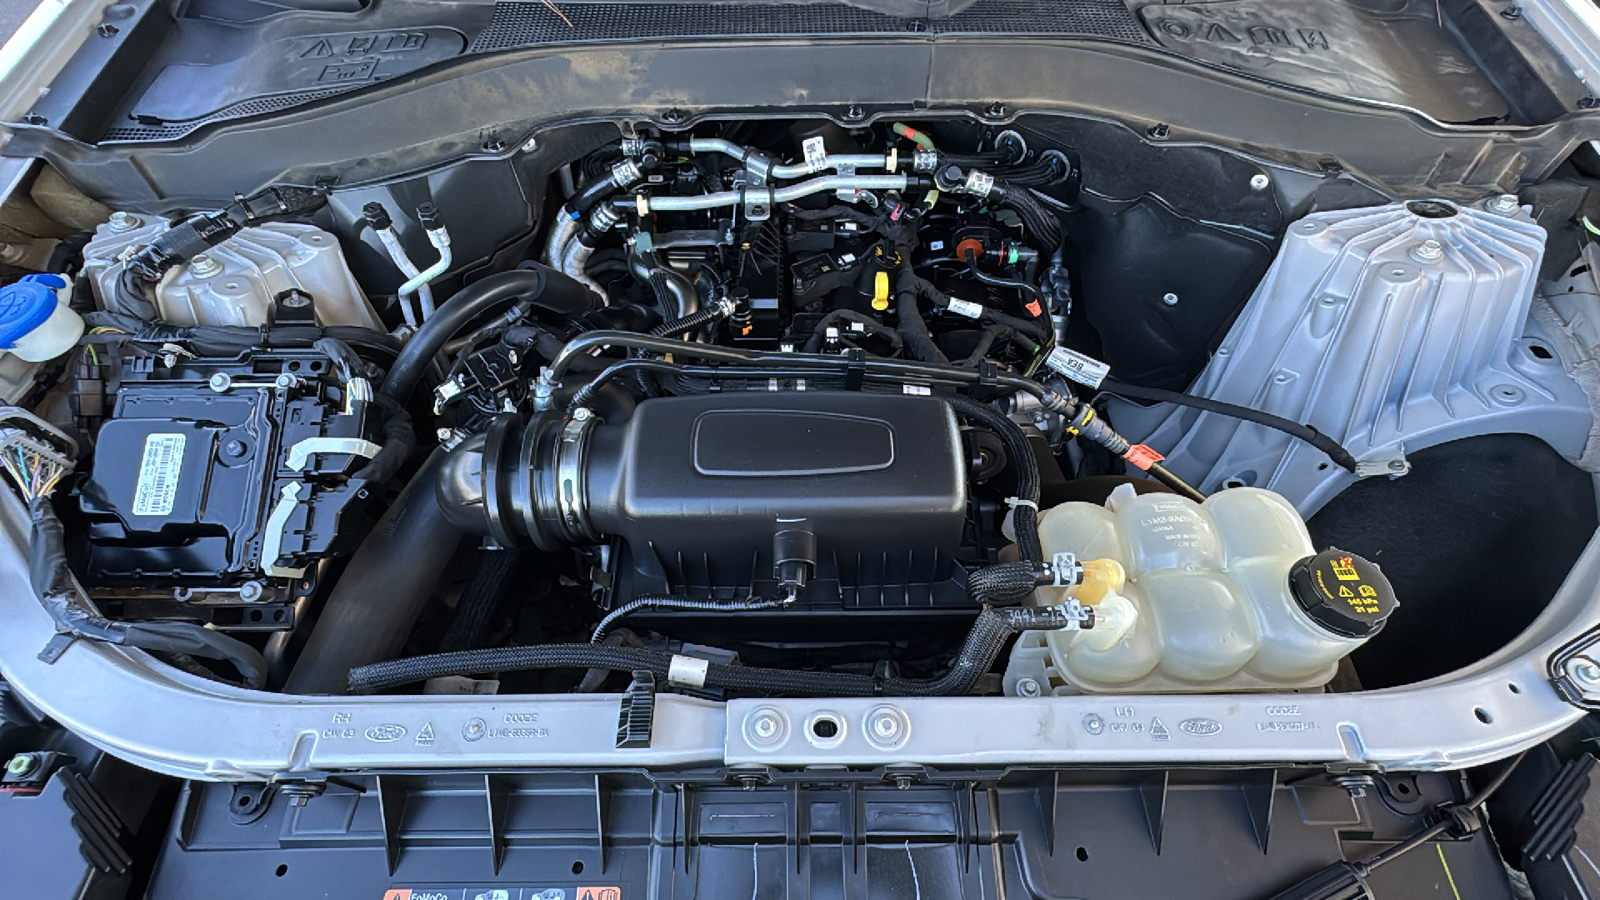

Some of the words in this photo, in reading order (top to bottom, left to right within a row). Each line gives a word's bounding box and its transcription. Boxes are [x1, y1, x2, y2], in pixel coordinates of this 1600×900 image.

[162, 484, 170, 504] BOSCH
[1347, 597, 1362, 606] 145
[1362, 597, 1379, 605] kPa
[1367, 606, 1380, 614] psi
[331, 712, 353, 724] RH
[368, 725, 404, 741] Ford
[1182, 719, 1220, 734] Ford
